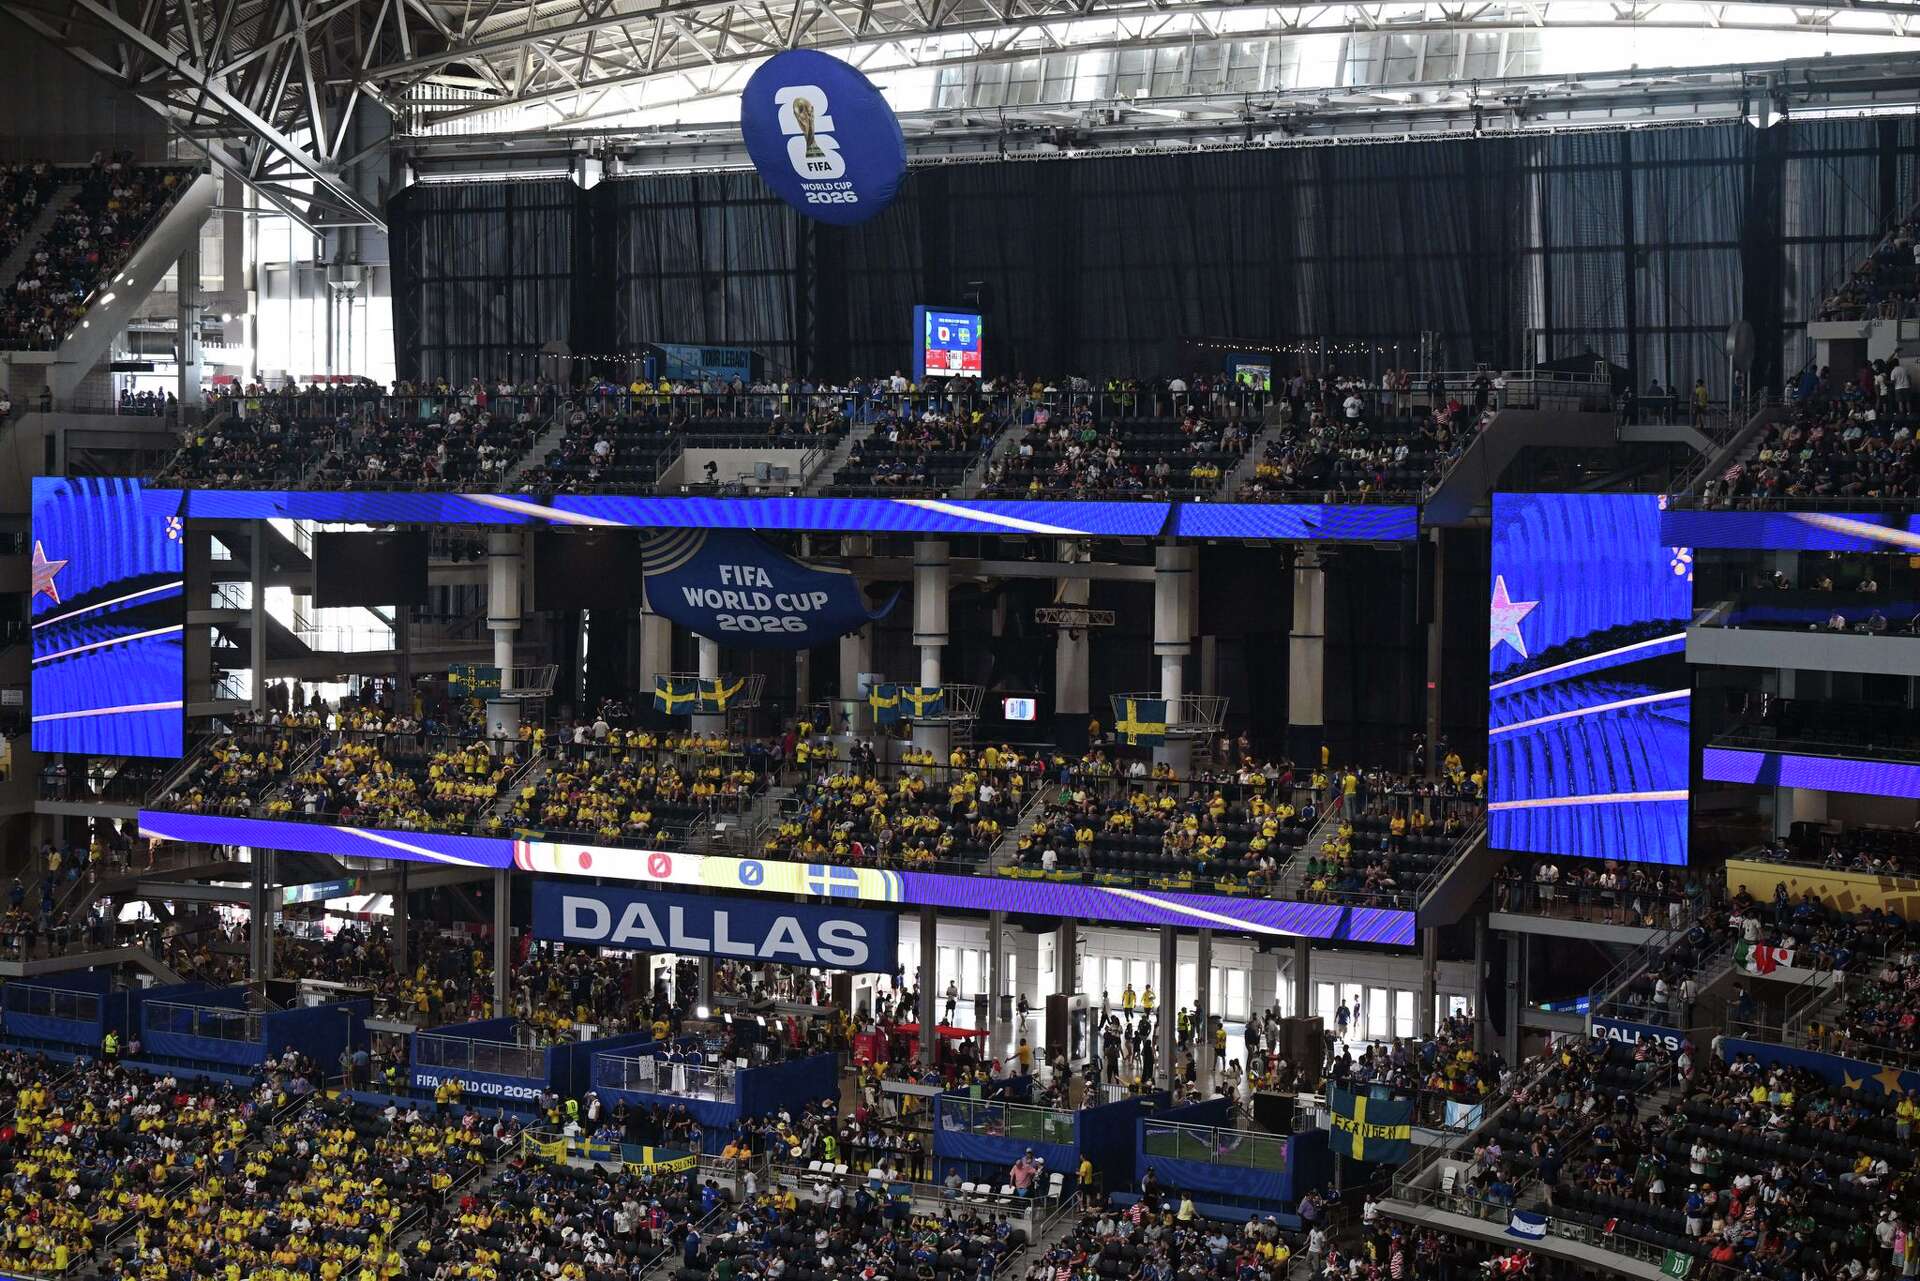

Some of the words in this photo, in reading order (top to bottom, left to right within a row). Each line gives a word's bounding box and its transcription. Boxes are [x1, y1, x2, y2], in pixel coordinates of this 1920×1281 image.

[807, 161, 832, 172] FIFA
[801, 182, 833, 191] WORLD
[834, 181, 853, 190] CUP
[805, 191, 859, 204] 2026
[719, 564, 774, 588] FIFA
[682, 587, 772, 611] WORLD
[775, 591, 829, 612] CUP
[716, 614, 808, 633] 2026
[647, 853, 672, 878] 0
[738, 860, 764, 886] 0
[562, 895, 869, 966] DALLAS
[416, 1074, 439, 1087] FIFA
[480, 1082, 503, 1095] CUP
